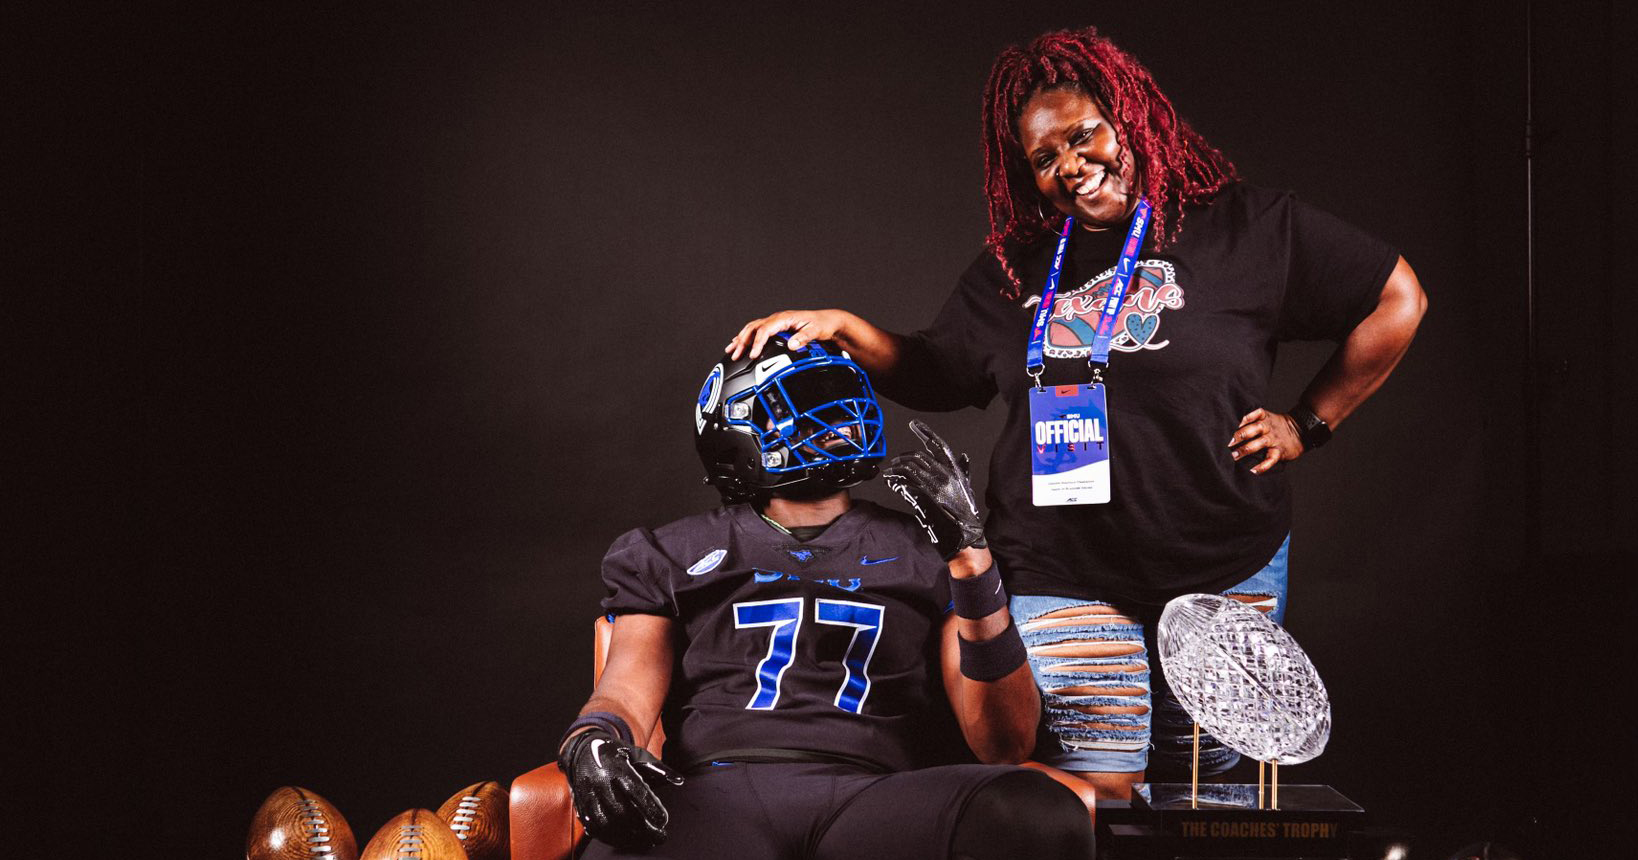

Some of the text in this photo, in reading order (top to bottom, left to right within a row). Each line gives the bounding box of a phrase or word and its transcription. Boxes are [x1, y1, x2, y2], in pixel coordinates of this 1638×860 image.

[1131, 216, 1145, 238] SMU
[1022, 284, 1185, 320] Texns
[1035, 418, 1104, 445] OFFICIAL
[1037, 442, 1104, 454] VISIT
[732, 597, 886, 715] 77
[1182, 821, 1338, 839] THE COACHES' TROPHY
